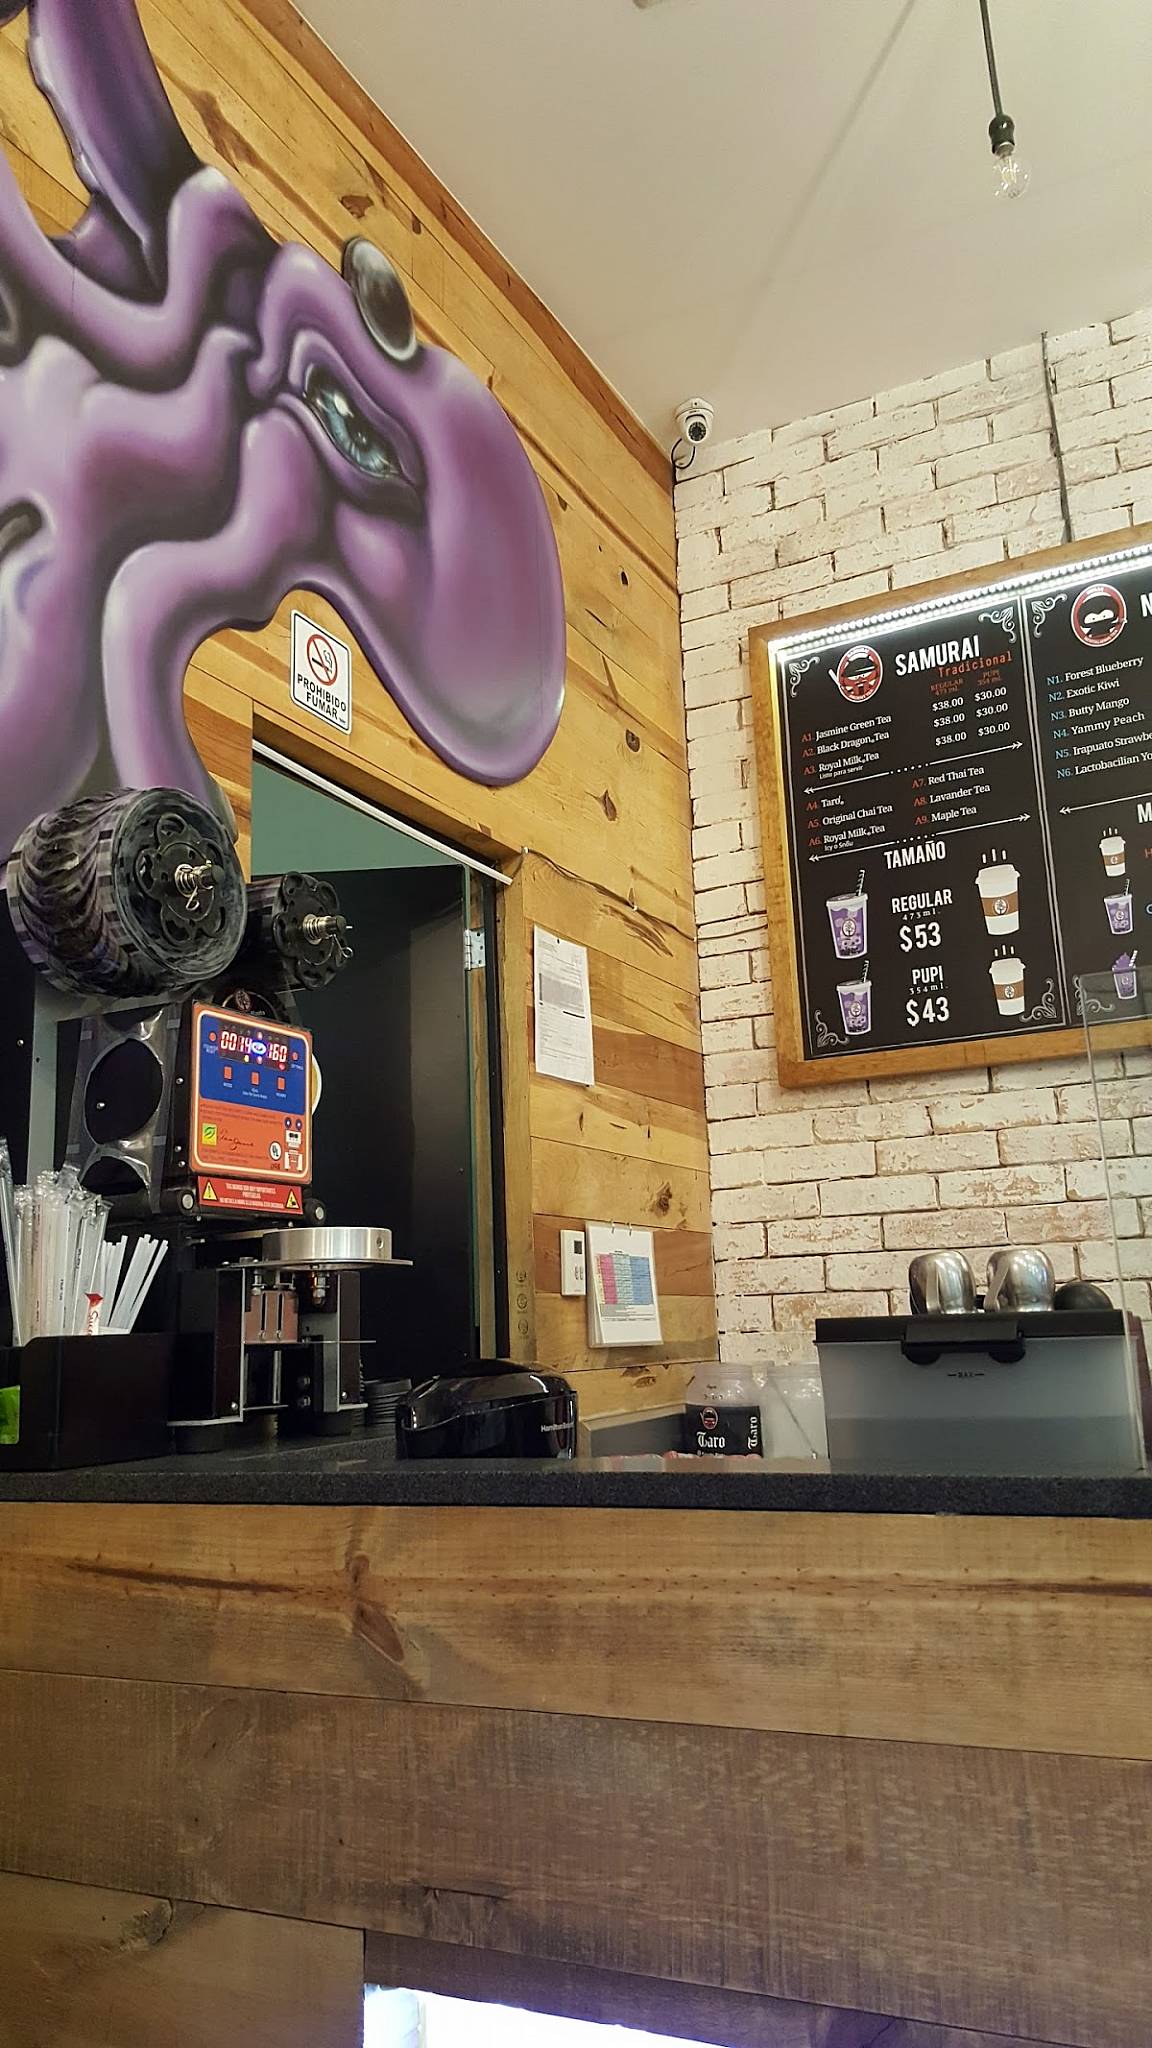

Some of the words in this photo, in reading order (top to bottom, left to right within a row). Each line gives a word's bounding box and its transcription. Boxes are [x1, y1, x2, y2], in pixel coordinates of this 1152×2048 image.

[895, 634, 980, 676] SAMURAI
[938, 650, 1012, 678] Tradicional
[1047, 675, 1063, 685] N1.
[1065, 668, 1094, 681] Forest
[1095, 656, 1144, 675] Blueberry
[297, 673, 347, 712] PROHIBIDO
[932, 696, 964, 712] $38.00
[974, 687, 1007, 702] $30.00
[1048, 692, 1065, 702] N2.
[1066, 685, 1096, 698] Exotic
[1097, 678, 1120, 691] Kiwi
[306, 692, 338, 720] FUMAR
[933, 713, 965, 728] $38.00
[976, 702, 1009, 718] $30.00
[1051, 711, 1067, 721] N3.
[1068, 705, 1094, 718] Butty
[1095, 697, 1130, 711] Mango
[815, 726, 849, 741] Jasmine
[849, 719, 875, 732] Green
[875, 715, 892, 725] Tea
[935, 731, 967, 746] $38.00
[978, 722, 1011, 737] $30.00
[1071, 720, 1111, 735] Yammy
[1113, 712, 1145, 726] Peach
[816, 742, 839, 755] Black
[840, 736, 871, 749] Dragon
[873, 731, 889, 741] Tea
[1072, 740, 1114, 756] Irapuato
[818, 759, 841, 772] Royal
[843, 755, 861, 767] Milk
[863, 752, 880, 762] Tea
[833, 769, 846, 778] para
[1075, 755, 1139, 775] Lactobacilian
[928, 774, 945, 785] Red
[946, 769, 967, 781] Thai
[967, 767, 985, 776] Tea
[930, 788, 973, 804] Lavander
[973, 784, 991, 794] Tea
[822, 811, 856, 825] Original
[856, 807, 876, 819] Chai
[876, 805, 893, 814] Tea
[931, 809, 959, 822] Maple
[960, 806, 977, 816] Tea
[823, 831, 846, 844] Royal
[848, 827, 867, 839] Milk
[869, 825, 886, 834] Tea
[884, 840, 946, 869] TAMAÑO
[891, 888, 953, 914] REGULAR
[899, 922, 941, 952] $53
[911, 965, 944, 985] PUPI
[906, 996, 949, 1027] $43
[696, 1431, 725, 1449] Taro
[747, 1416, 758, 1450] Taro
